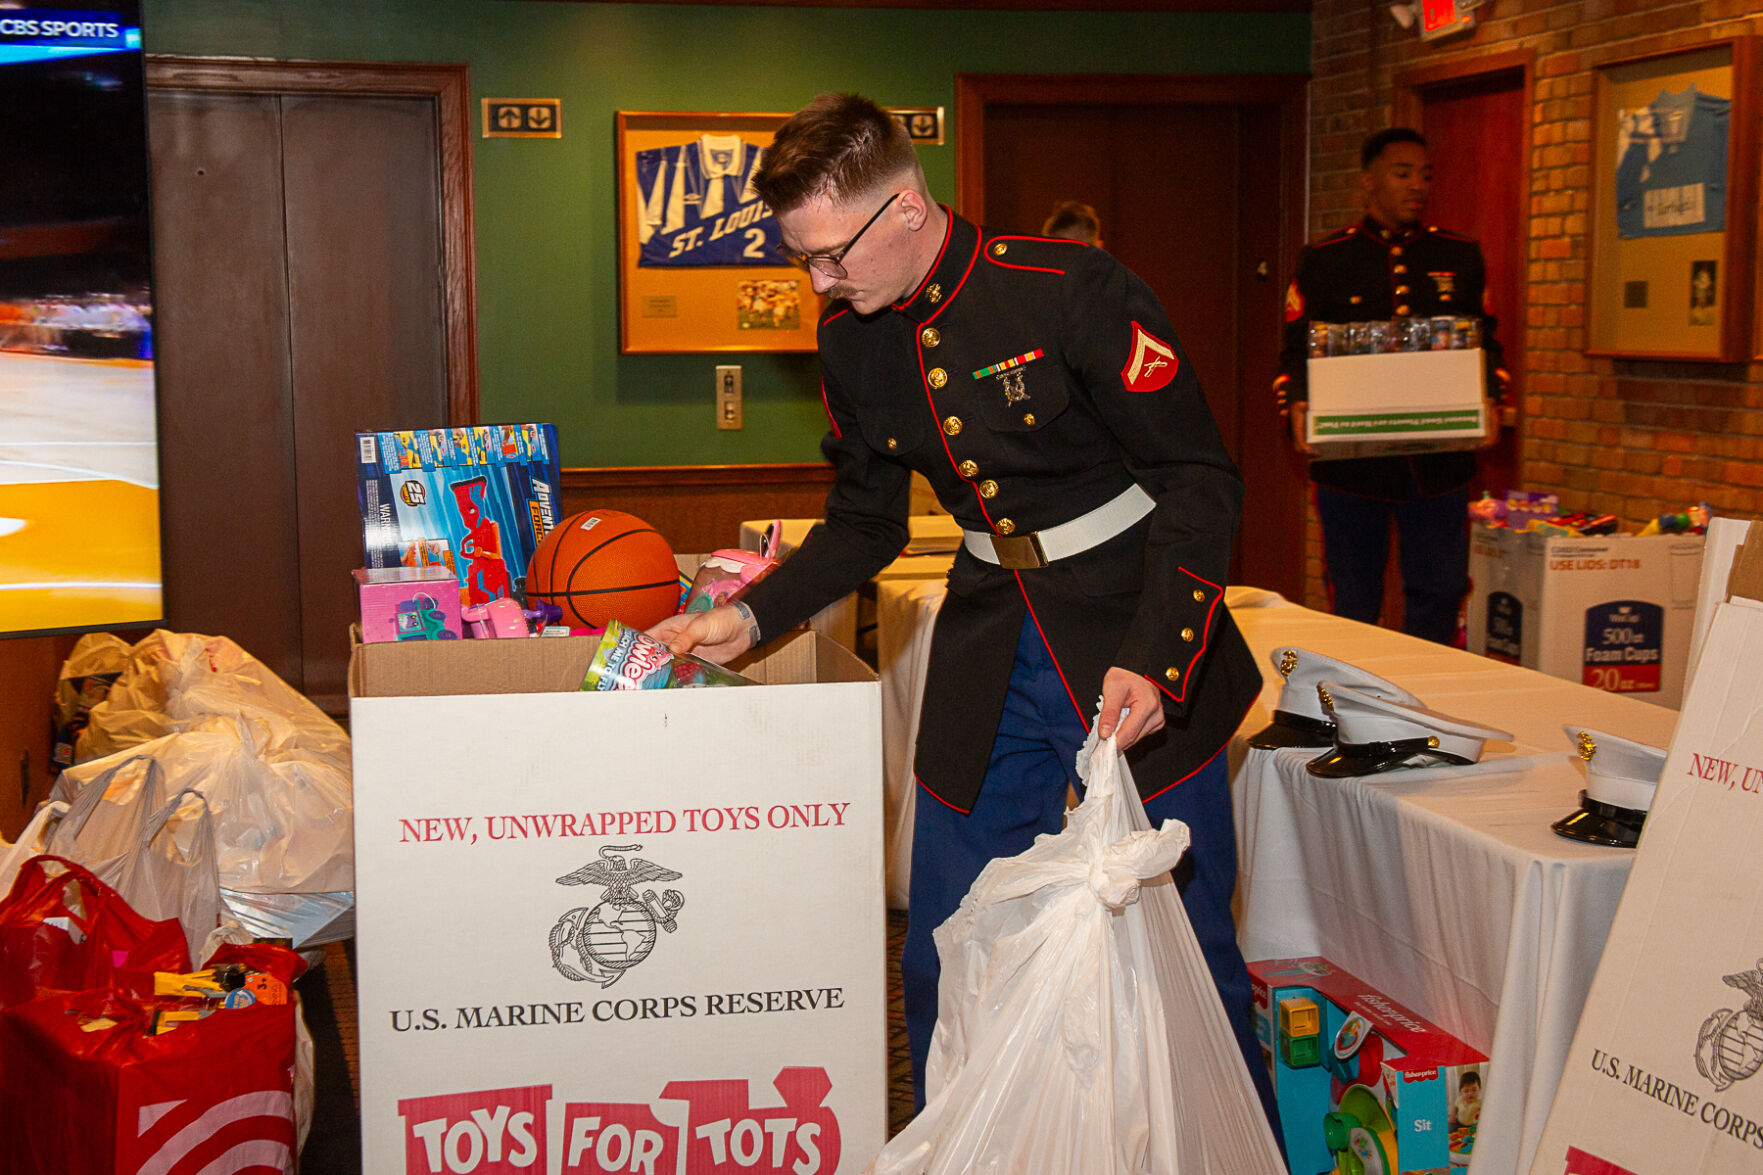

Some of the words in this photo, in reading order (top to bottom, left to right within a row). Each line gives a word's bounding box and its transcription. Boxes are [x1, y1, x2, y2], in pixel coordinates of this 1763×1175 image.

[0, 19, 39, 35] CBS
[40, 20, 119, 38] SPORTS
[668, 226, 704, 258] ST.
[743, 227, 766, 258] 2
[406, 481, 426, 505] 25
[531, 505, 544, 543] FORC
[1550, 559, 1574, 571] USE
[604, 662, 616, 675] TO
[612, 648, 624, 662] ME
[1586, 648, 1622, 662] Foam
[1624, 647, 1658, 663] Cups
[1590, 668, 1619, 691] 20
[1686, 752, 1739, 791] NEW,
[399, 817, 479, 846] NEW,
[484, 810, 678, 840] UNWRAPPED
[683, 806, 760, 833] TOYS
[767, 802, 850, 829] ONLY
[389, 1008, 448, 1032] U.S.
[454, 1002, 585, 1030] MARINE
[592, 994, 697, 1022] CORPS
[704, 987, 845, 1016] RESERVE
[1591, 1049, 1620, 1080] U.S.
[1623, 1064, 1699, 1116] MARINE
[1700, 1101, 1763, 1150] CORPS
[1414, 1119, 1432, 1132] Sit
[412, 1105, 538, 1175] TOYS
[568, 1115, 664, 1175] FOR
[695, 1117, 821, 1175] TOTS
